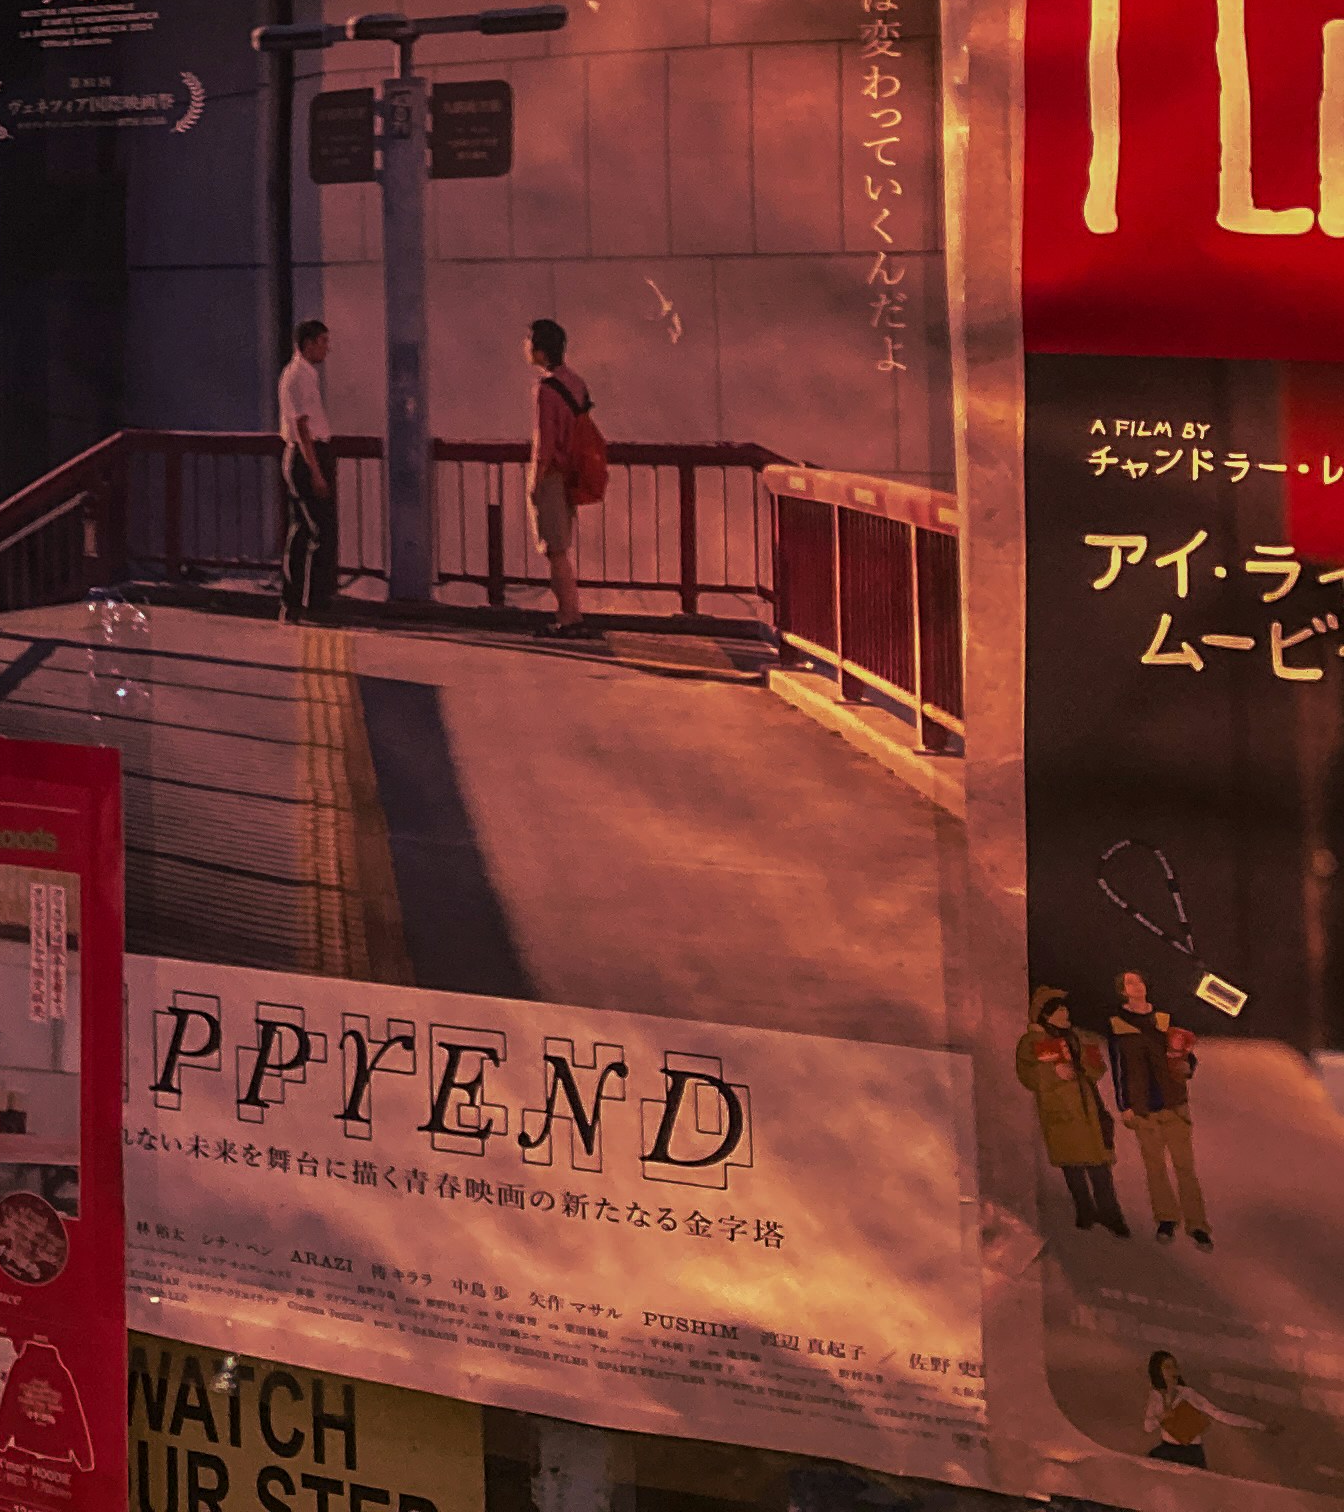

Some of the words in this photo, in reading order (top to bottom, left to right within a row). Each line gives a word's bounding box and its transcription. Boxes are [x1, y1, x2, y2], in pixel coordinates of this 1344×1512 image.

[1090, 419, 1109, 440] A
[1115, 420, 1174, 439] FILM
[1183, 422, 1211, 441] BY
[1083, 532, 1344, 599] アイ・ラ
[1140, 614, 1344, 681] ムービ
[290, 1249, 353, 1274] ARAZI
[451, 1277, 487, 1300] 中島
[529, 1289, 564, 1312] 矢作
[570, 1300, 623, 1320] マサル
[641, 1310, 740, 1341] PUSHIM
[806, 1336, 866, 1362] 真起子
[909, 1352, 952, 1377] 佐野
[128, 1345, 359, 1472] WATCH
